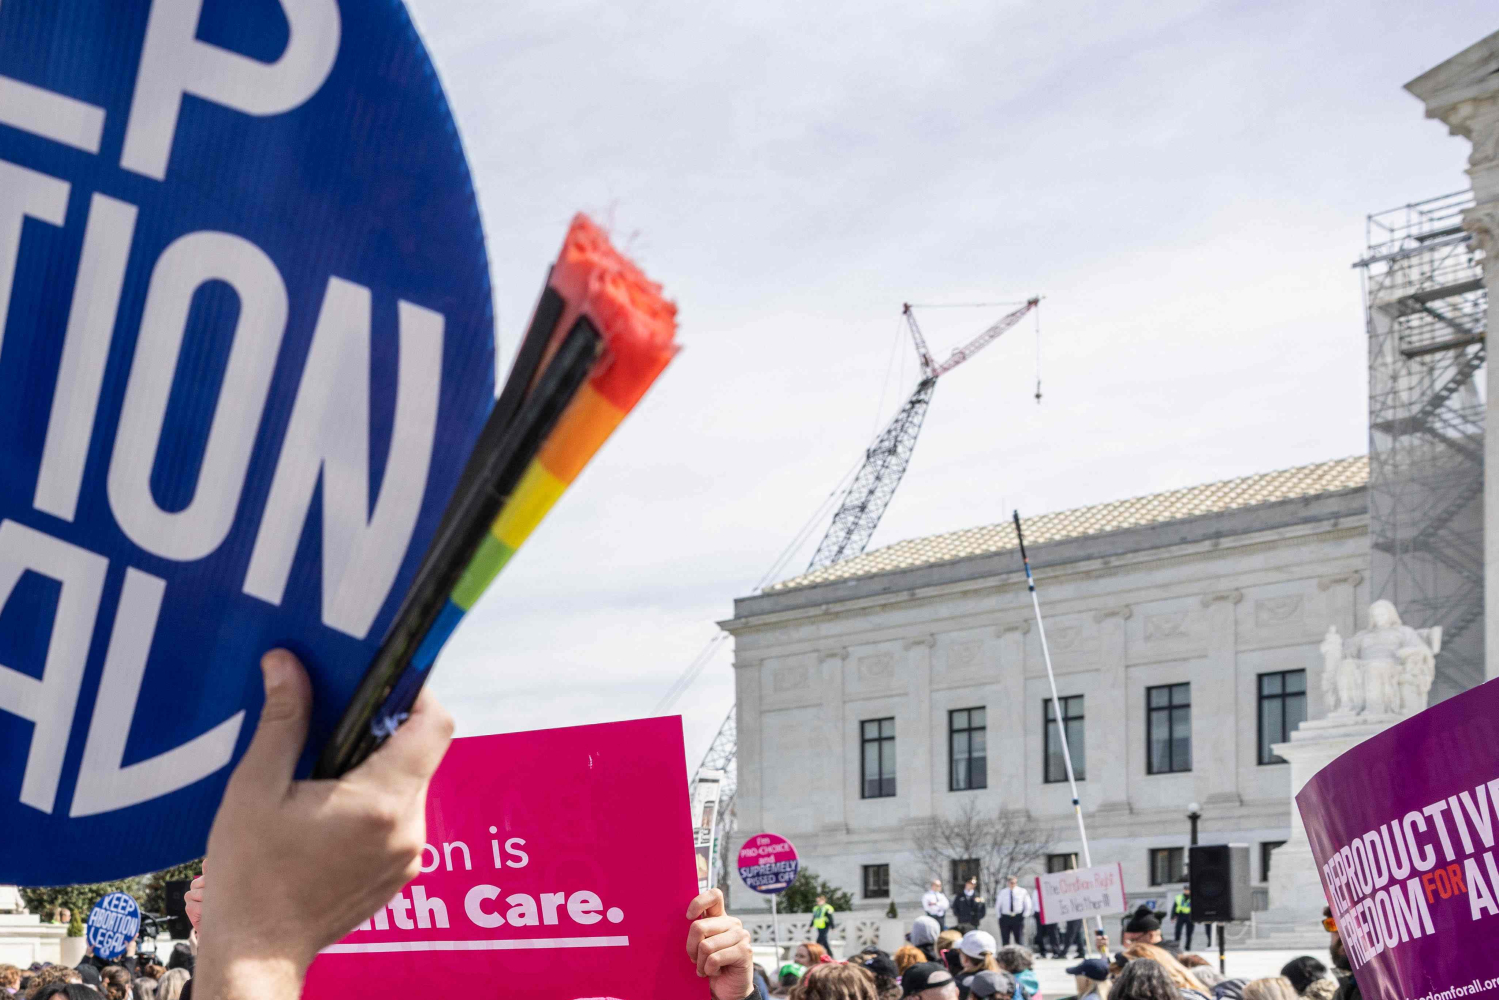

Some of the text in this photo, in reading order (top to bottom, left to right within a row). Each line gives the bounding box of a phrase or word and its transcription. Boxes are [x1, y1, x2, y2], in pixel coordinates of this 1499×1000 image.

[489, 826, 529, 869] is
[88, 906, 138, 937] ABORTION
[102, 893, 135, 914] KEEP
[464, 884, 625, 928] Care.
[1340, 877, 1435, 970] FREEDOM
[1422, 863, 1468, 904] FOR
[89, 926, 126, 953] LEGAL
